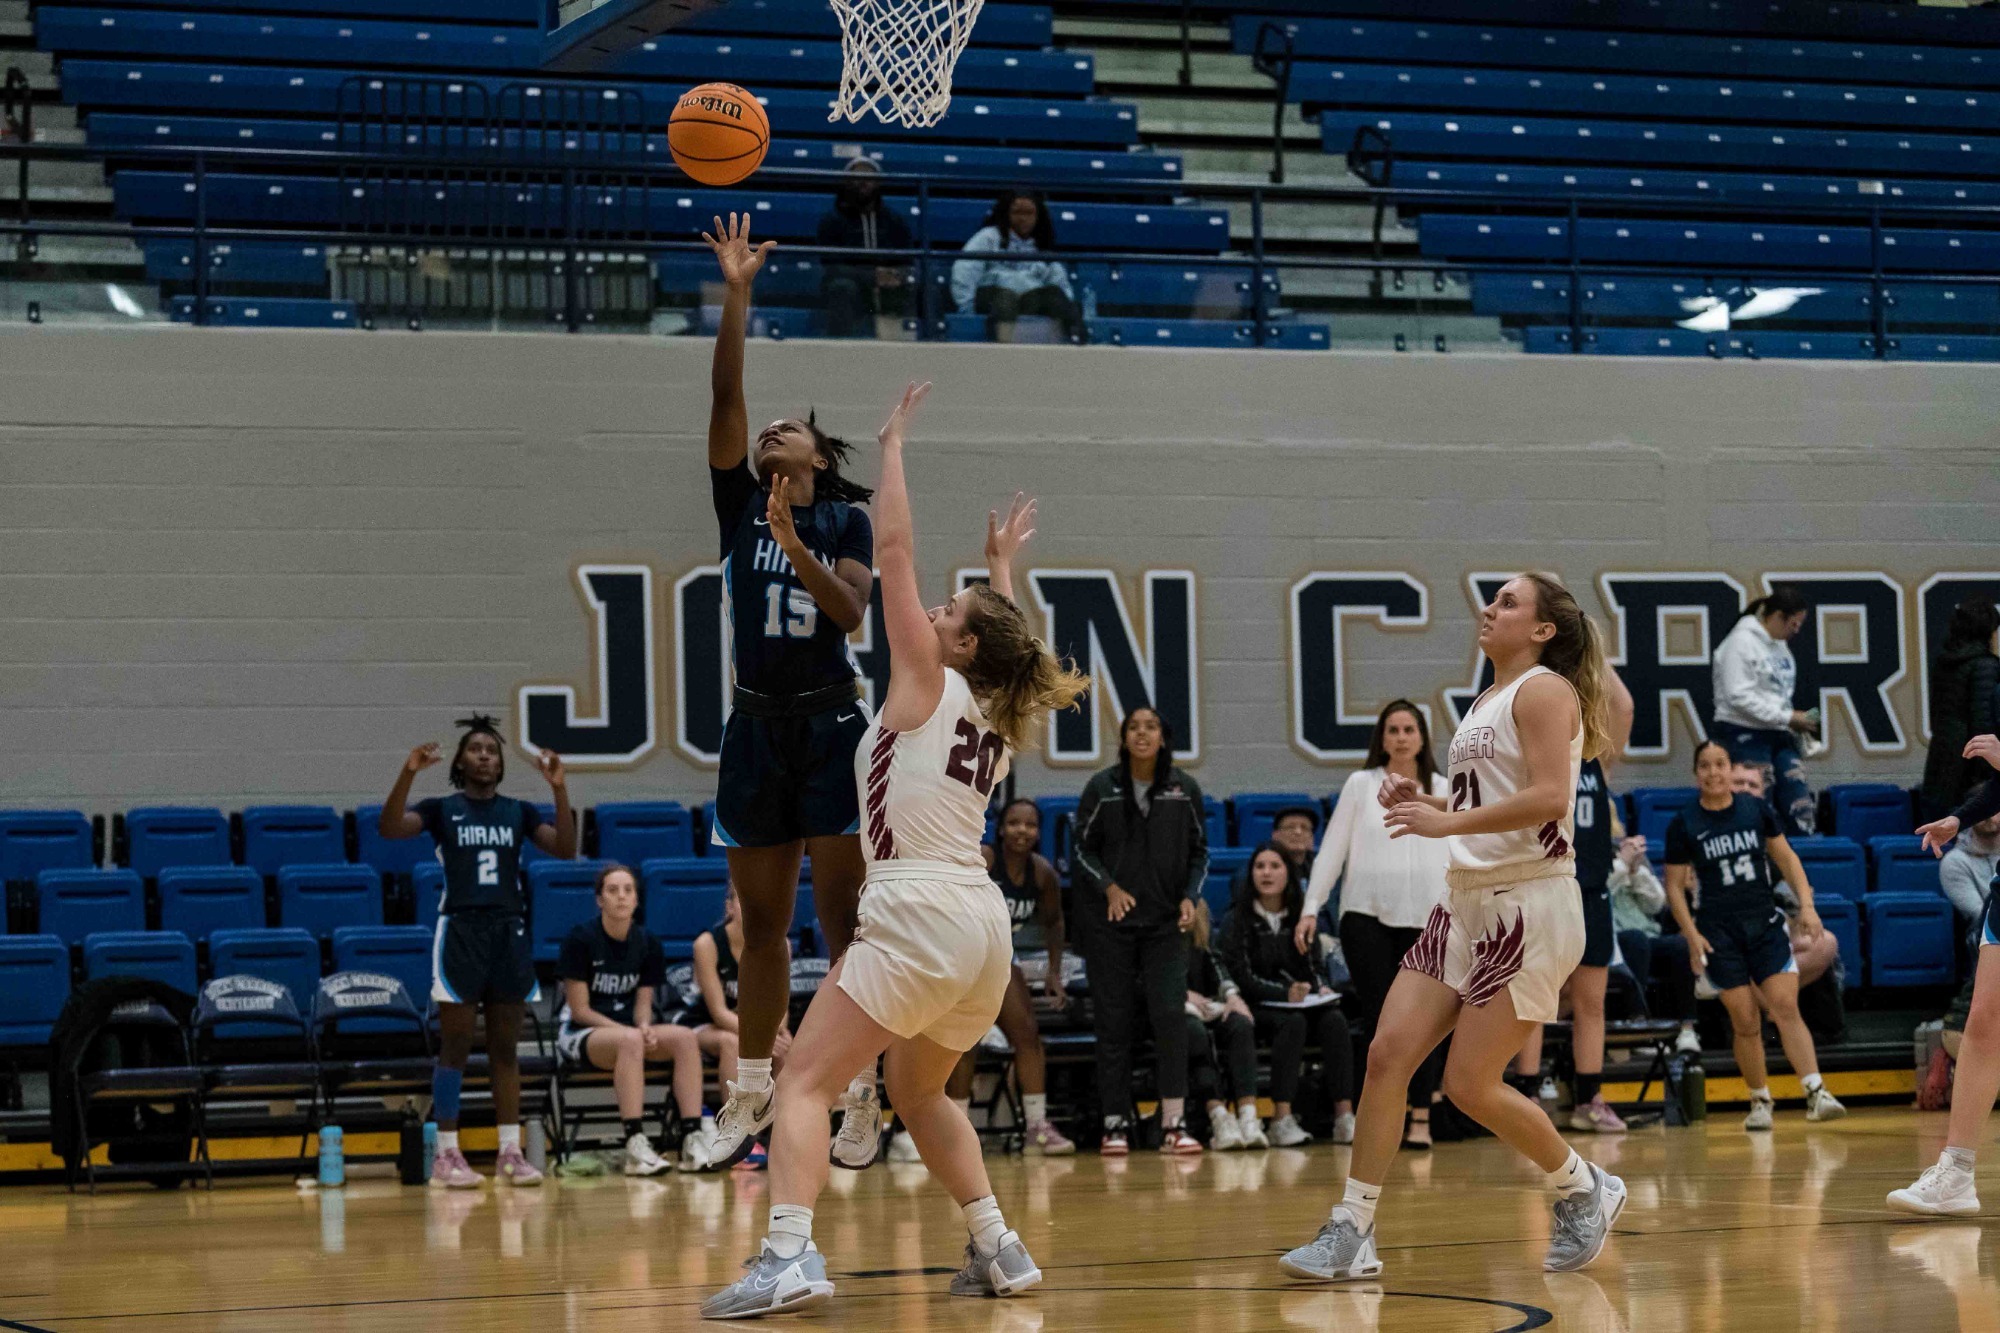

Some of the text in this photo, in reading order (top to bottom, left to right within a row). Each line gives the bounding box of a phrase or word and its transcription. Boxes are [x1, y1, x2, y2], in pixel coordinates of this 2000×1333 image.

[680, 96, 743, 121] Wilson
[764, 582, 818, 639] 15
[518, 565, 2000, 763] JN CRR
[945, 716, 1004, 798] 20
[1448, 726, 1495, 767] SHER
[1451, 768, 1482, 812] 21
[457, 825, 514, 847] HIRAM
[1703, 829, 1759, 859] HIRAM
[477, 849, 499, 885] 2
[1719, 854, 1756, 886] 14
